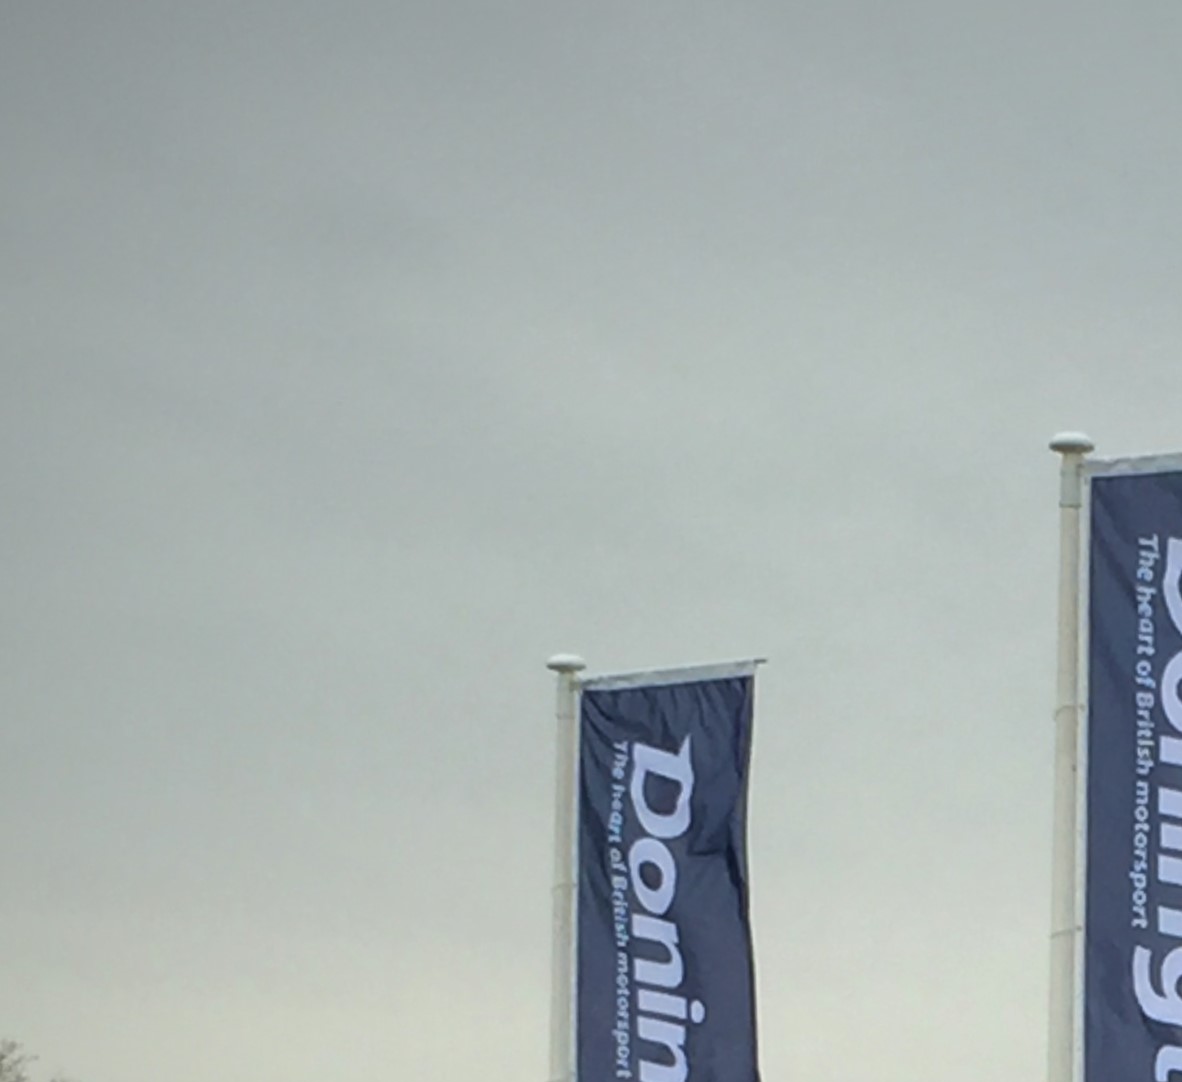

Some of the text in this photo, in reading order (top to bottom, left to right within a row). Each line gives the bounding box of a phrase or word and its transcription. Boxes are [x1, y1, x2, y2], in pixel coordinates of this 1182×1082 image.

[608, 740, 632, 1079] The heart of British motorsport
[1130, 534, 1159, 929] The heart of British motorsport
